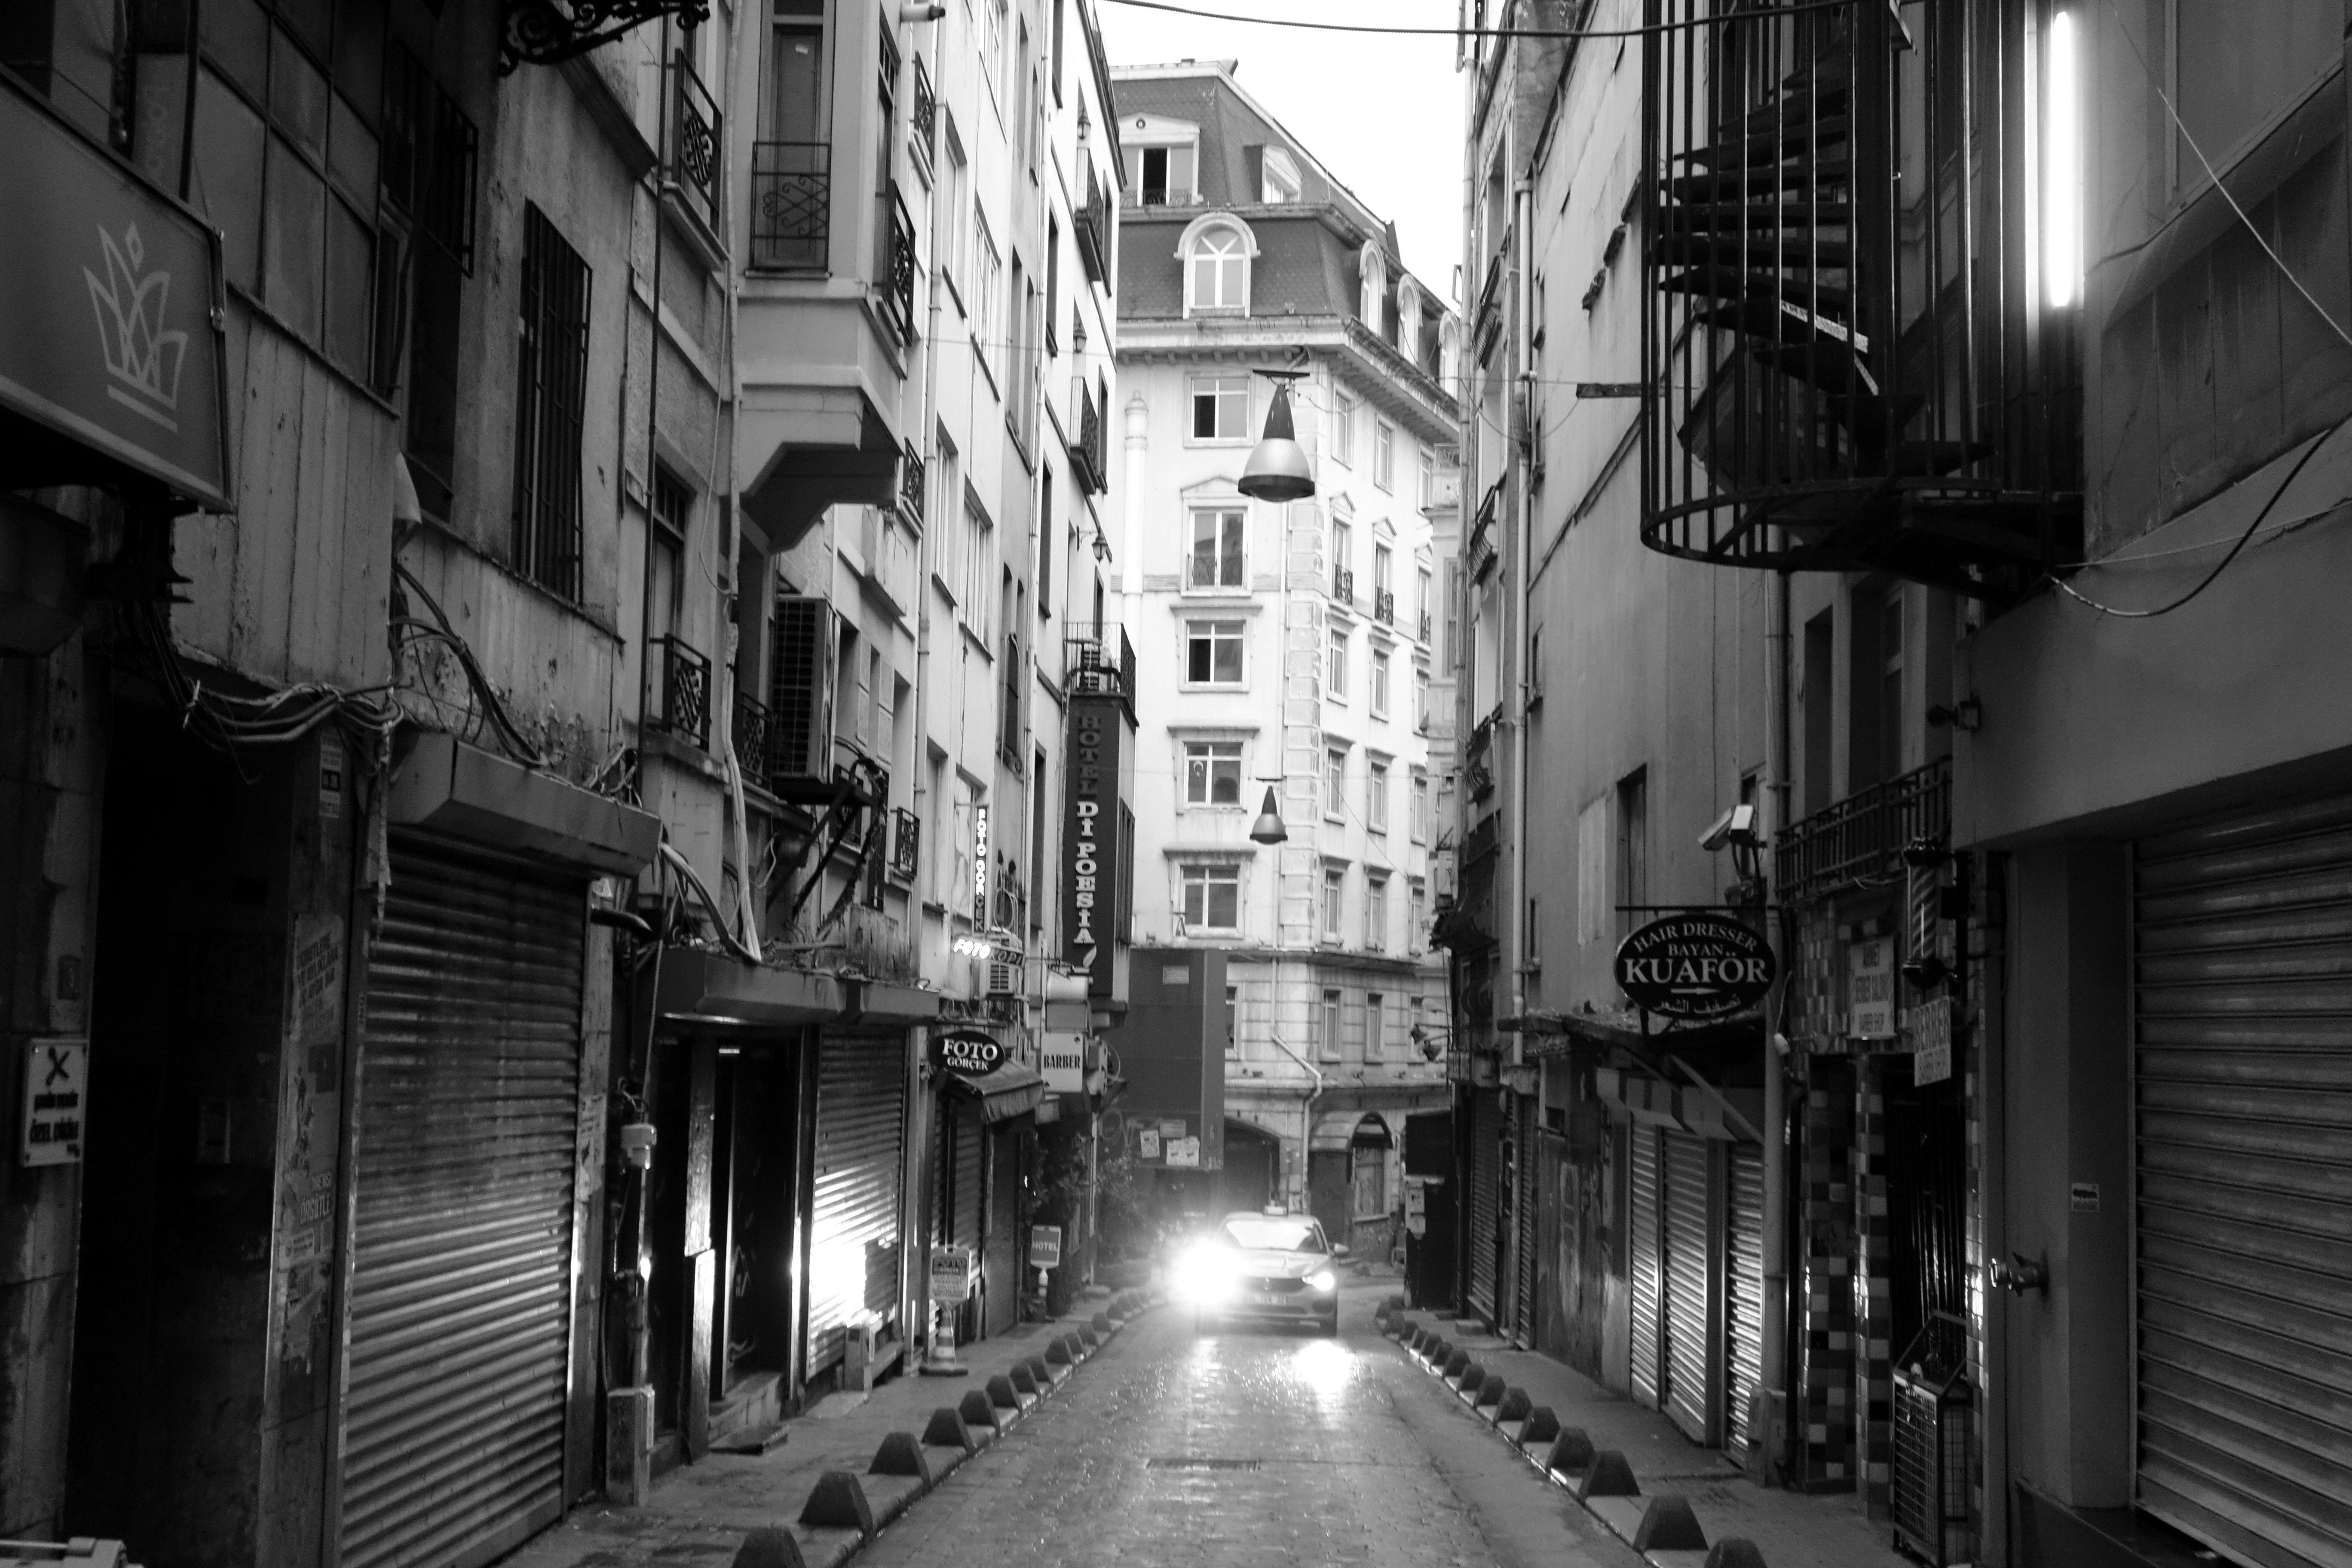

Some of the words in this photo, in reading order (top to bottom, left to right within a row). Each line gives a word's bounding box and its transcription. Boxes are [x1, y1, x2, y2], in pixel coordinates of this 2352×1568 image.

[1078, 716, 1101, 796] HOTEL
[977, 809, 986, 856] FOTO
[1077, 801, 1099, 836] DI
[1074, 842, 1096, 944] POESIA
[1634, 925, 1678, 952] HAIR
[1683, 923, 1758, 952] DRESSER
[1668, 943, 1723, 956] BAYAN
[1624, 951, 1769, 983] KUAFÖR
[942, 1038, 998, 1061] FOTO
[1044, 1054, 1080, 1069] BARBER
[1032, 1240, 1058, 1252] HOTEL
